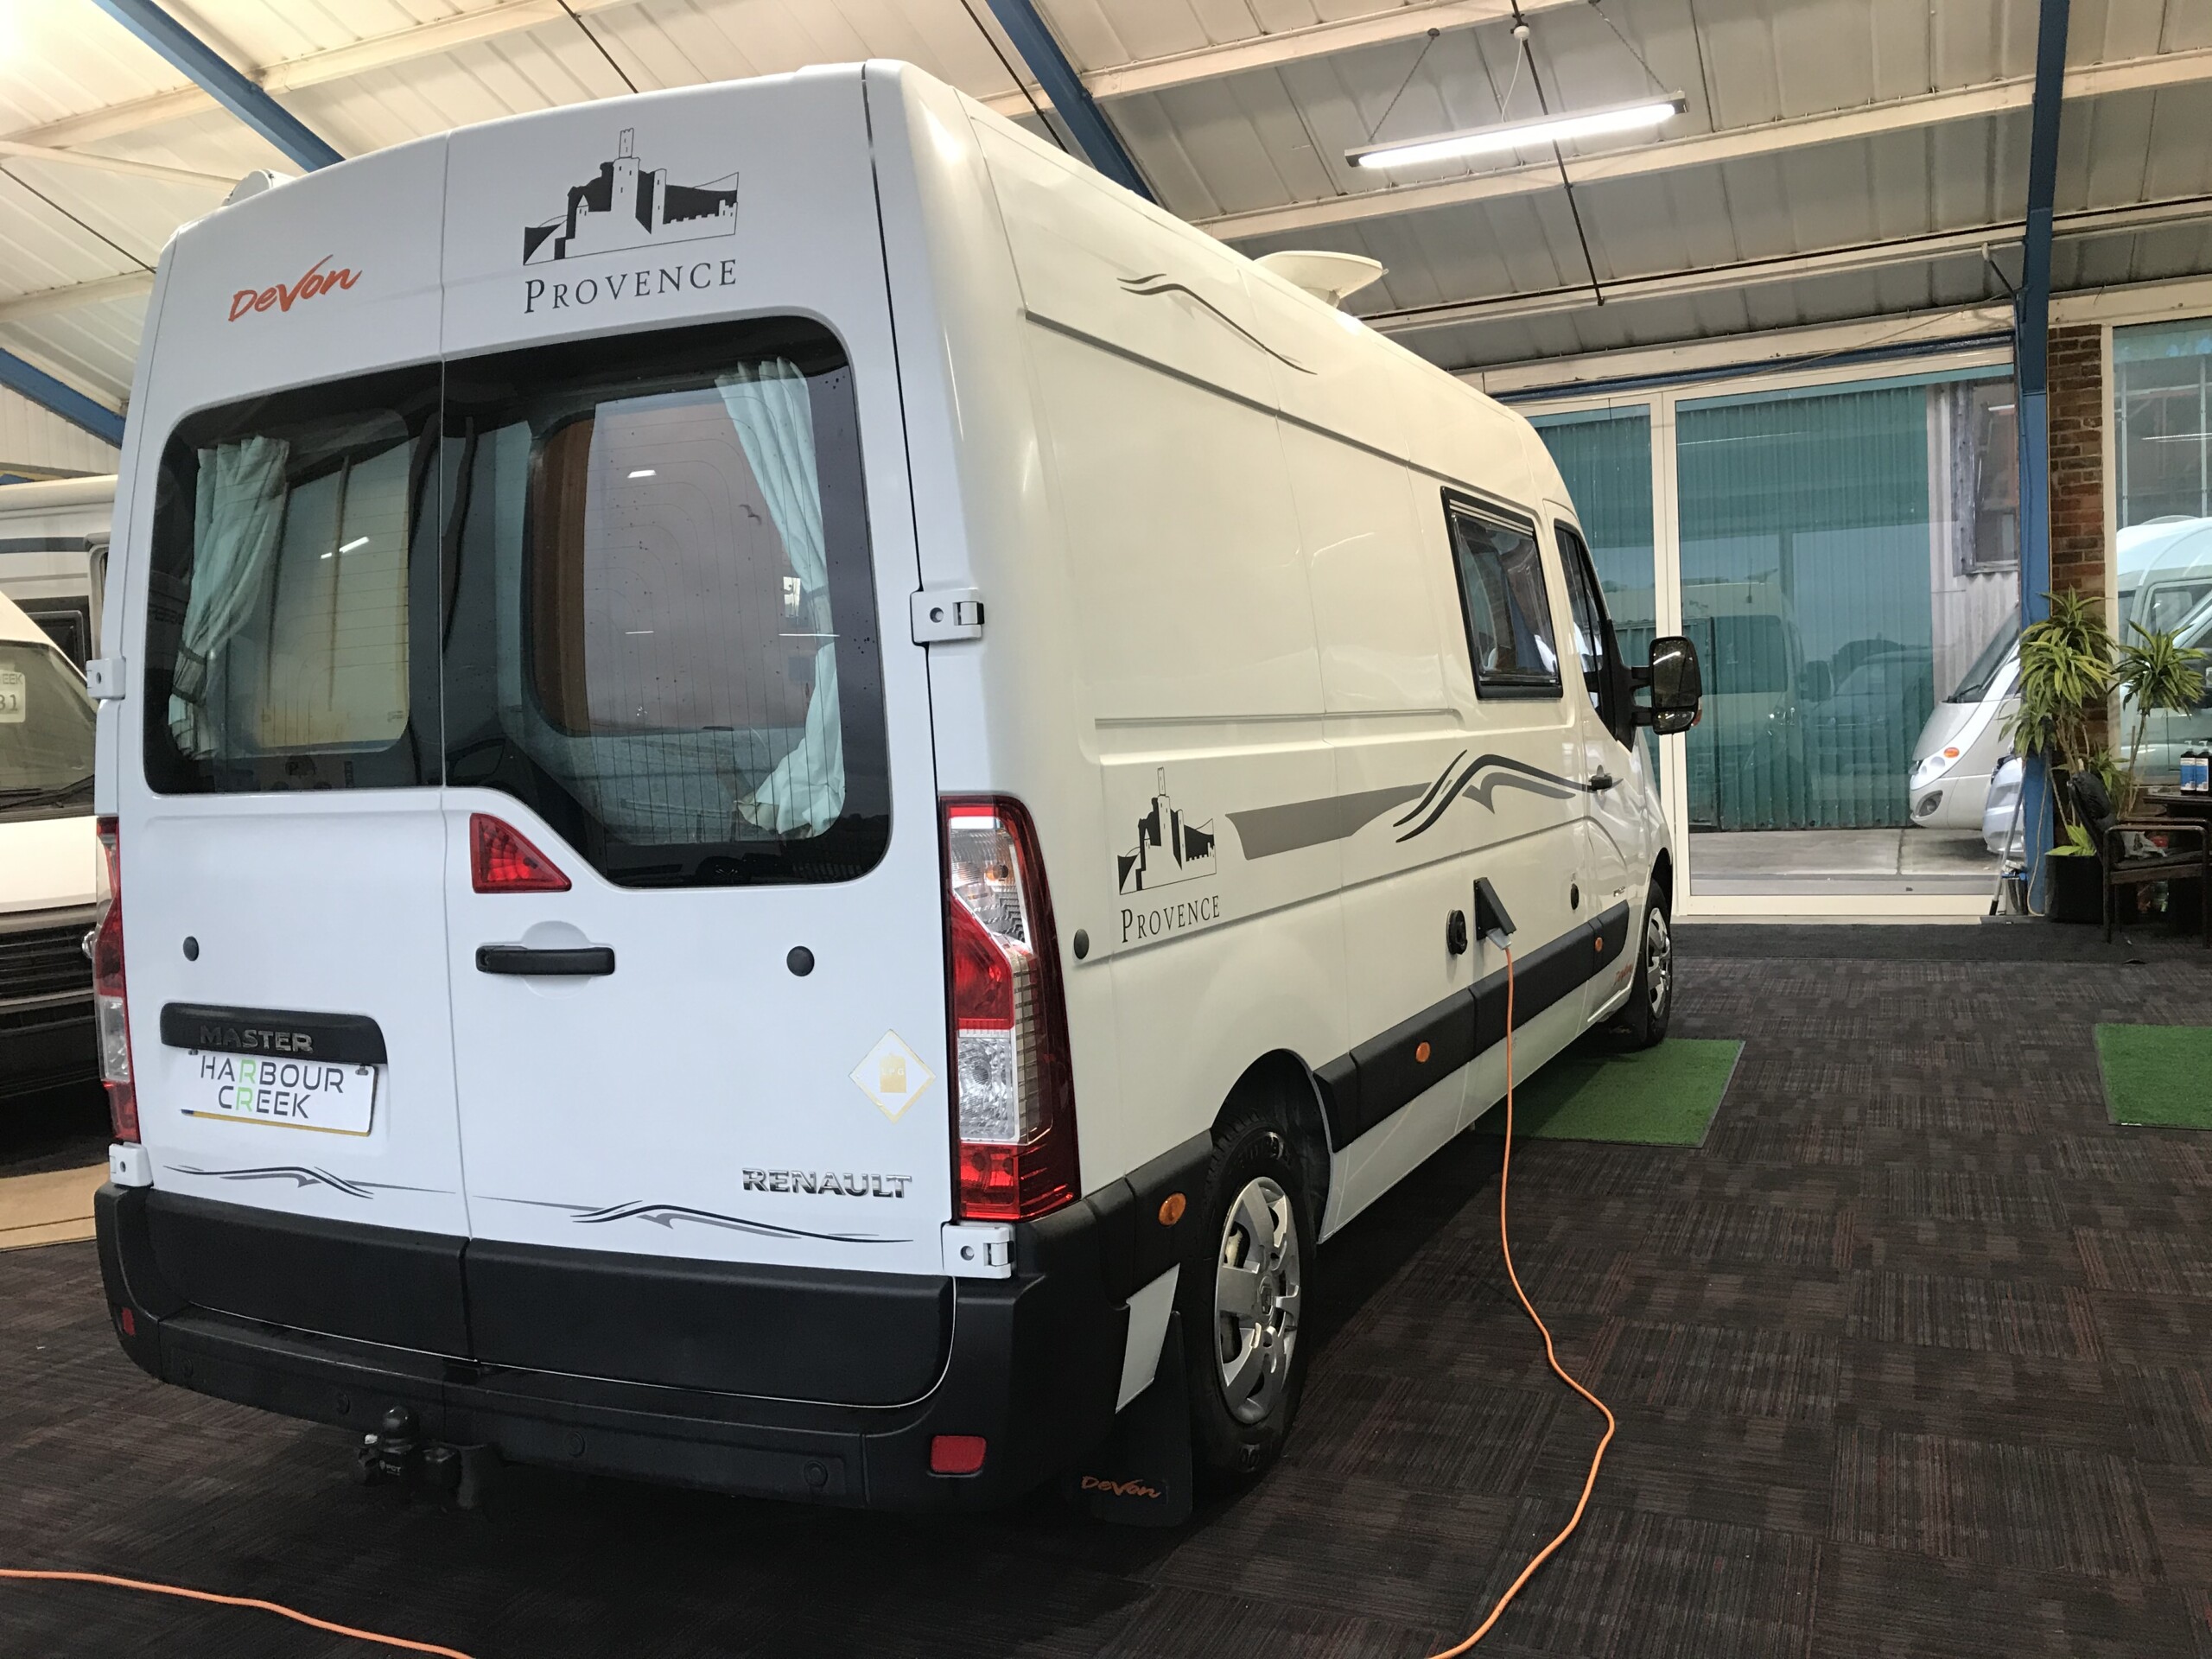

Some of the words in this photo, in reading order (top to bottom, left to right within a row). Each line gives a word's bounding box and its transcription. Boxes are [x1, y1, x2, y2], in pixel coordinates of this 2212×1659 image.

[524, 259, 736, 314] PROVENCE
[1121, 895, 1220, 944] PROVENCE
[200, 1025, 314, 1054] MASTER
[200, 1055, 344, 1094] HARBOUR
[218, 1085, 311, 1119] CREEK
[741, 1168, 912, 1198] RENAULT
